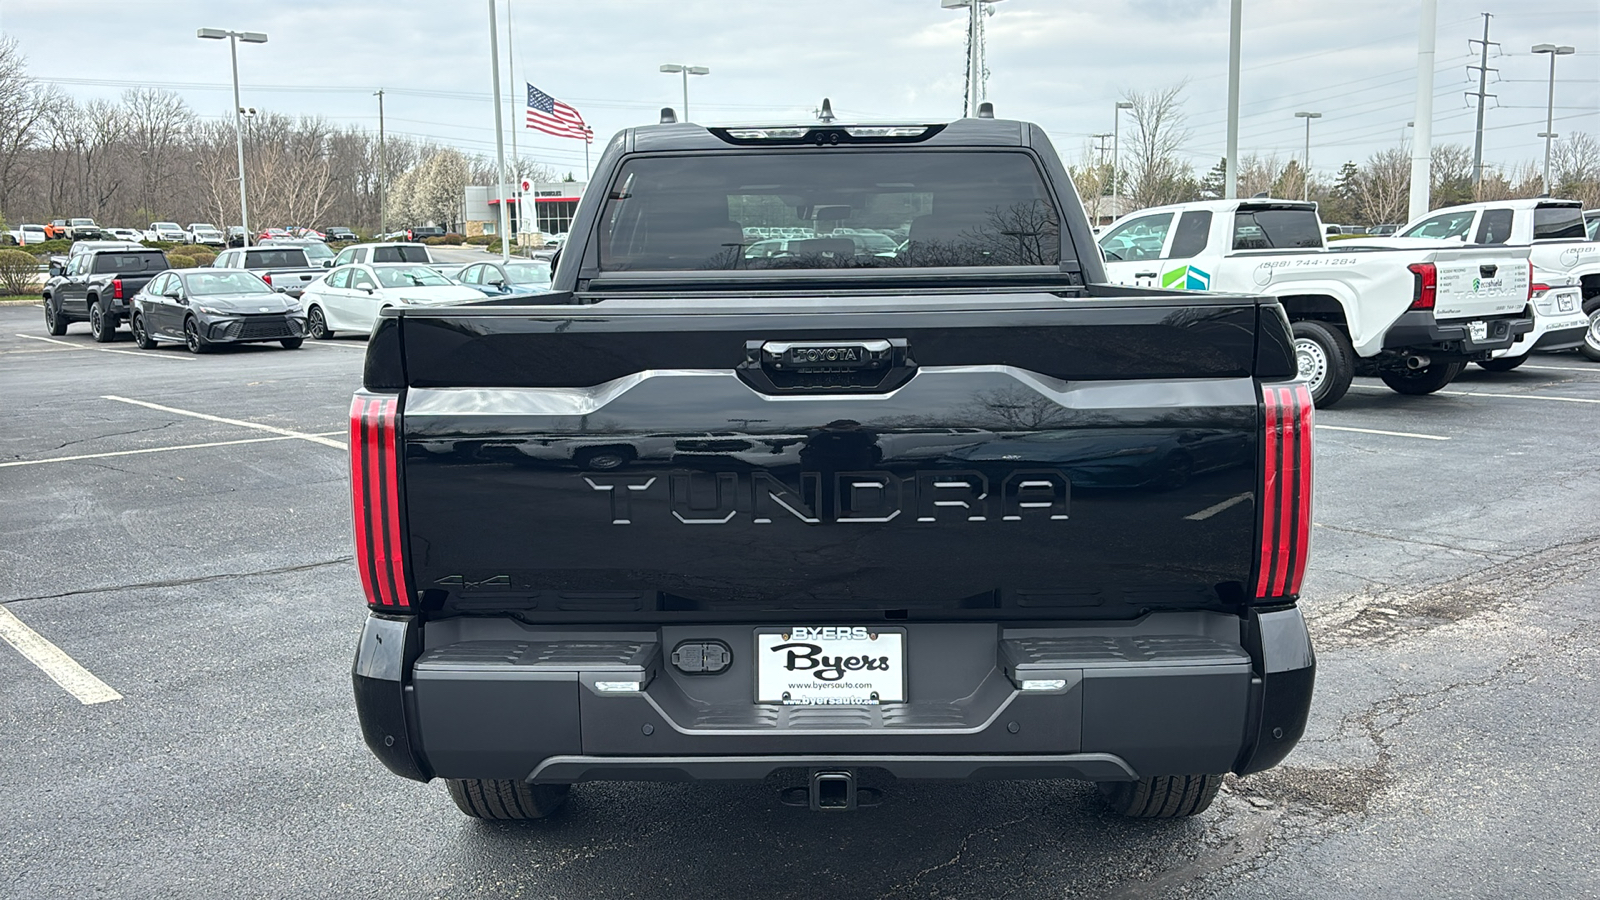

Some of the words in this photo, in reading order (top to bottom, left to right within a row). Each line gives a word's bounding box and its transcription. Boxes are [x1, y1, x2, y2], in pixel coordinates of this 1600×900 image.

[1260, 260, 1291, 269] (888)
[1296, 258, 1357, 266] 744-1284
[1453, 288, 1517, 299] TACOMA
[798, 348, 857, 361] TOYOTA
[582, 470, 1071, 525] TUNDRA
[791, 626, 868, 641] BYERS
[770, 643, 890, 682] Byers
[788, 681, 873, 690] www.byersauto.com
[782, 694, 880, 706] www.byersauto.com
